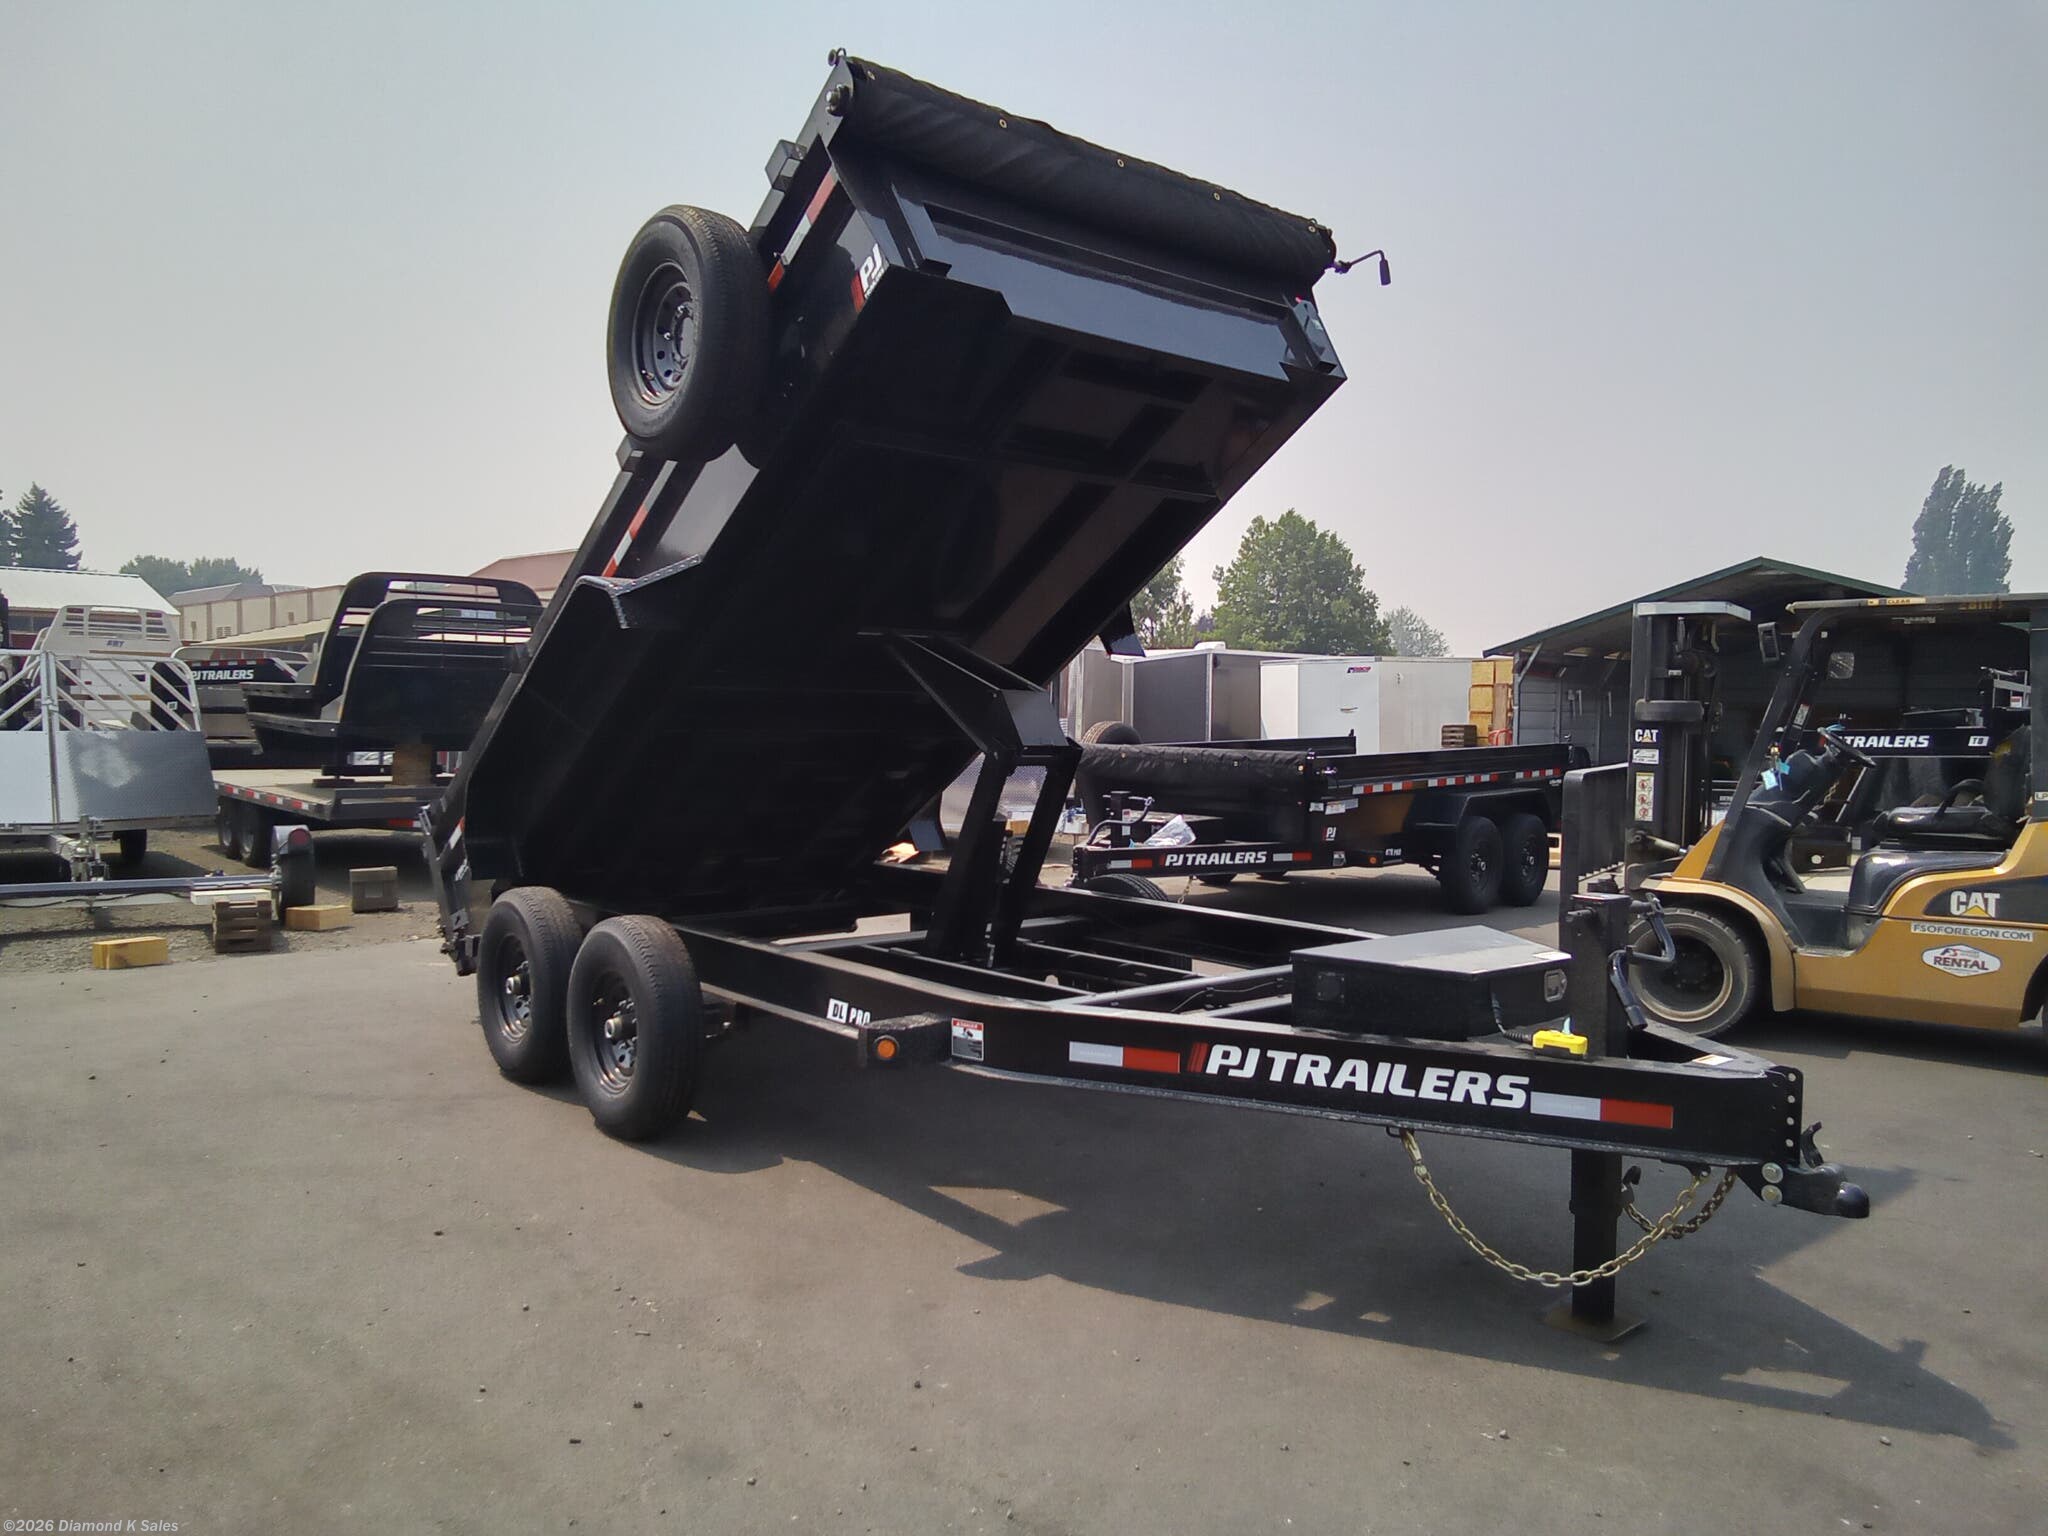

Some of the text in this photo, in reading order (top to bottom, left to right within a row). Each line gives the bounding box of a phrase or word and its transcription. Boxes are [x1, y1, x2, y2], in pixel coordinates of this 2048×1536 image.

[860, 243, 882, 293] PJ
[1635, 729, 1659, 742] CAT
[1326, 827, 1337, 838] PJ
[1950, 891, 2000, 918] CAT
[1933, 956, 1990, 971] RENTAL
[849, 1008, 871, 1026] PRO
